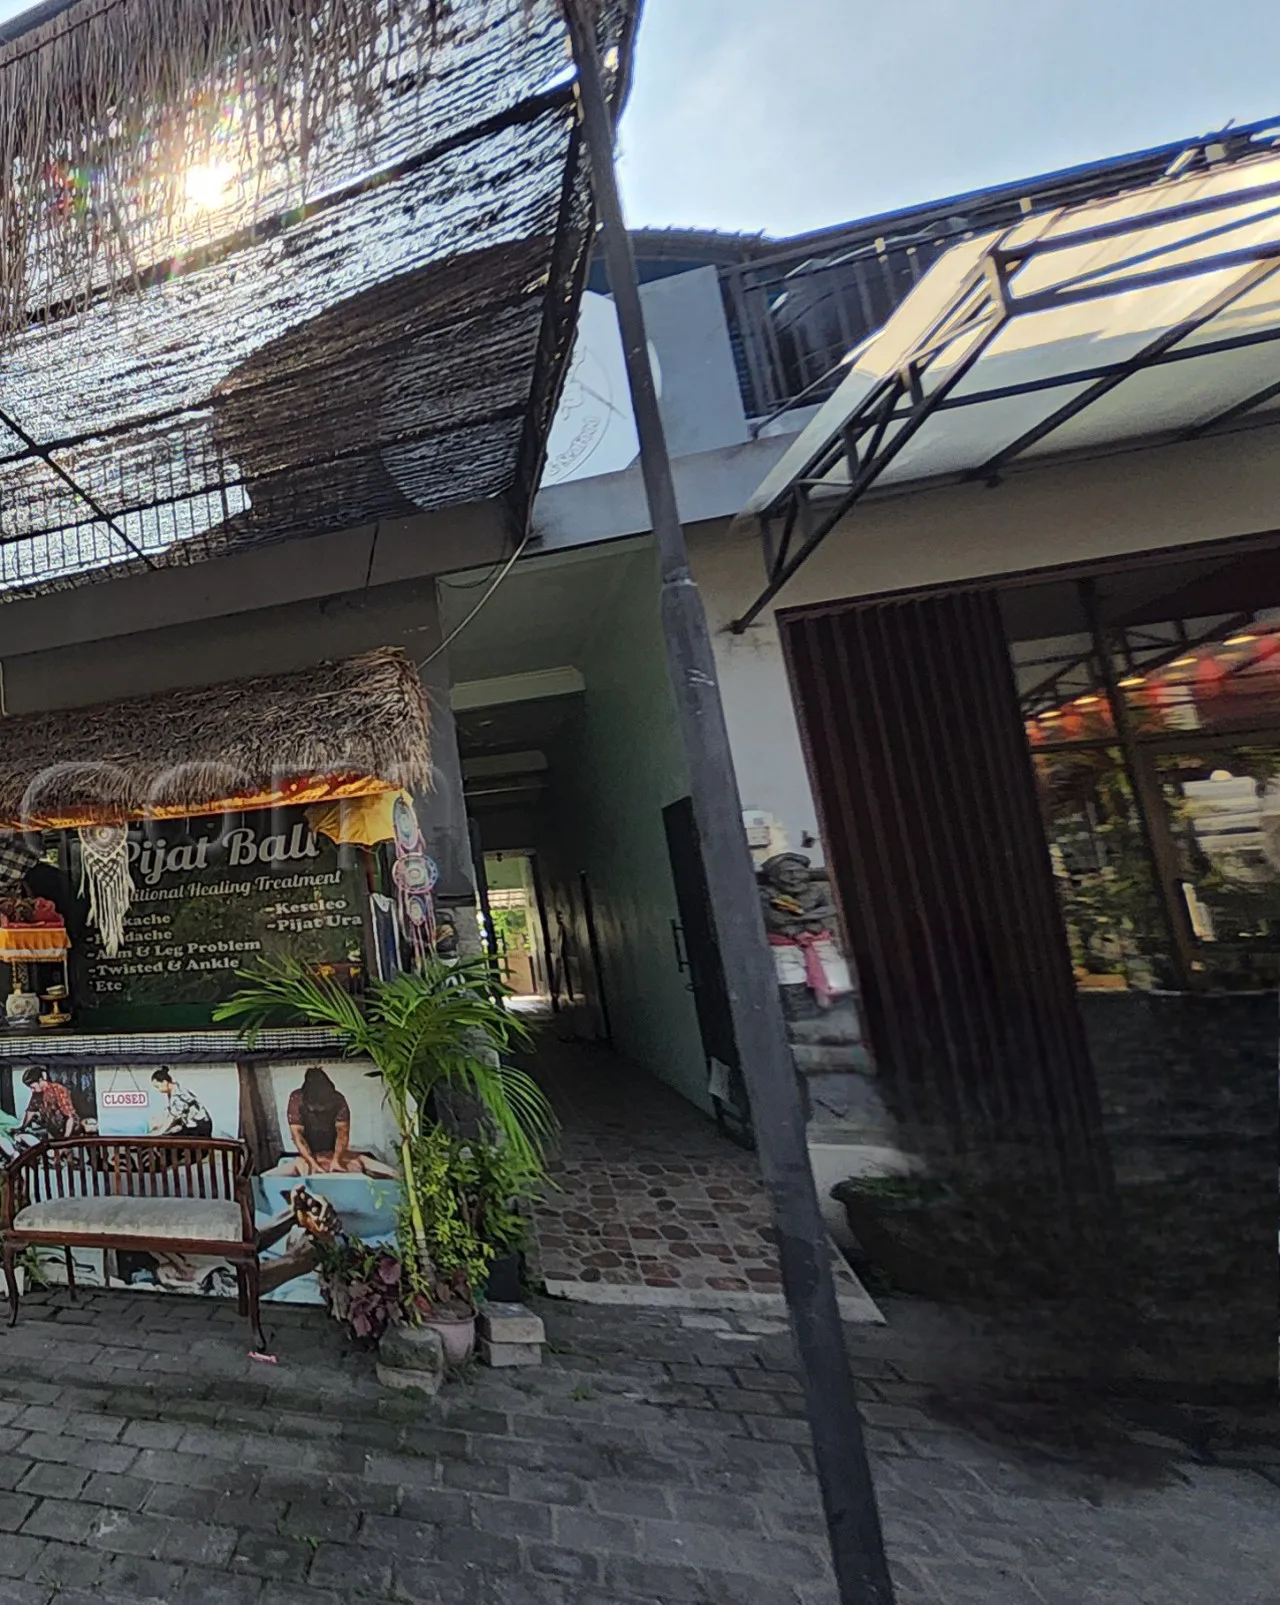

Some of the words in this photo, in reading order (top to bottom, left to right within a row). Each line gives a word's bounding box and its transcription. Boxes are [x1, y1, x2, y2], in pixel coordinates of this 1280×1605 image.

[187, 877, 251, 898] Healing
[254, 870, 341, 891] Treatment
[136, 946, 150, 957] &
[154, 944, 182, 958] Leg
[187, 940, 261, 955] Problem
[167, 960, 182, 972] &
[187, 957, 240, 971] Ankle
[104, 1094, 146, 1105] CLOSED
